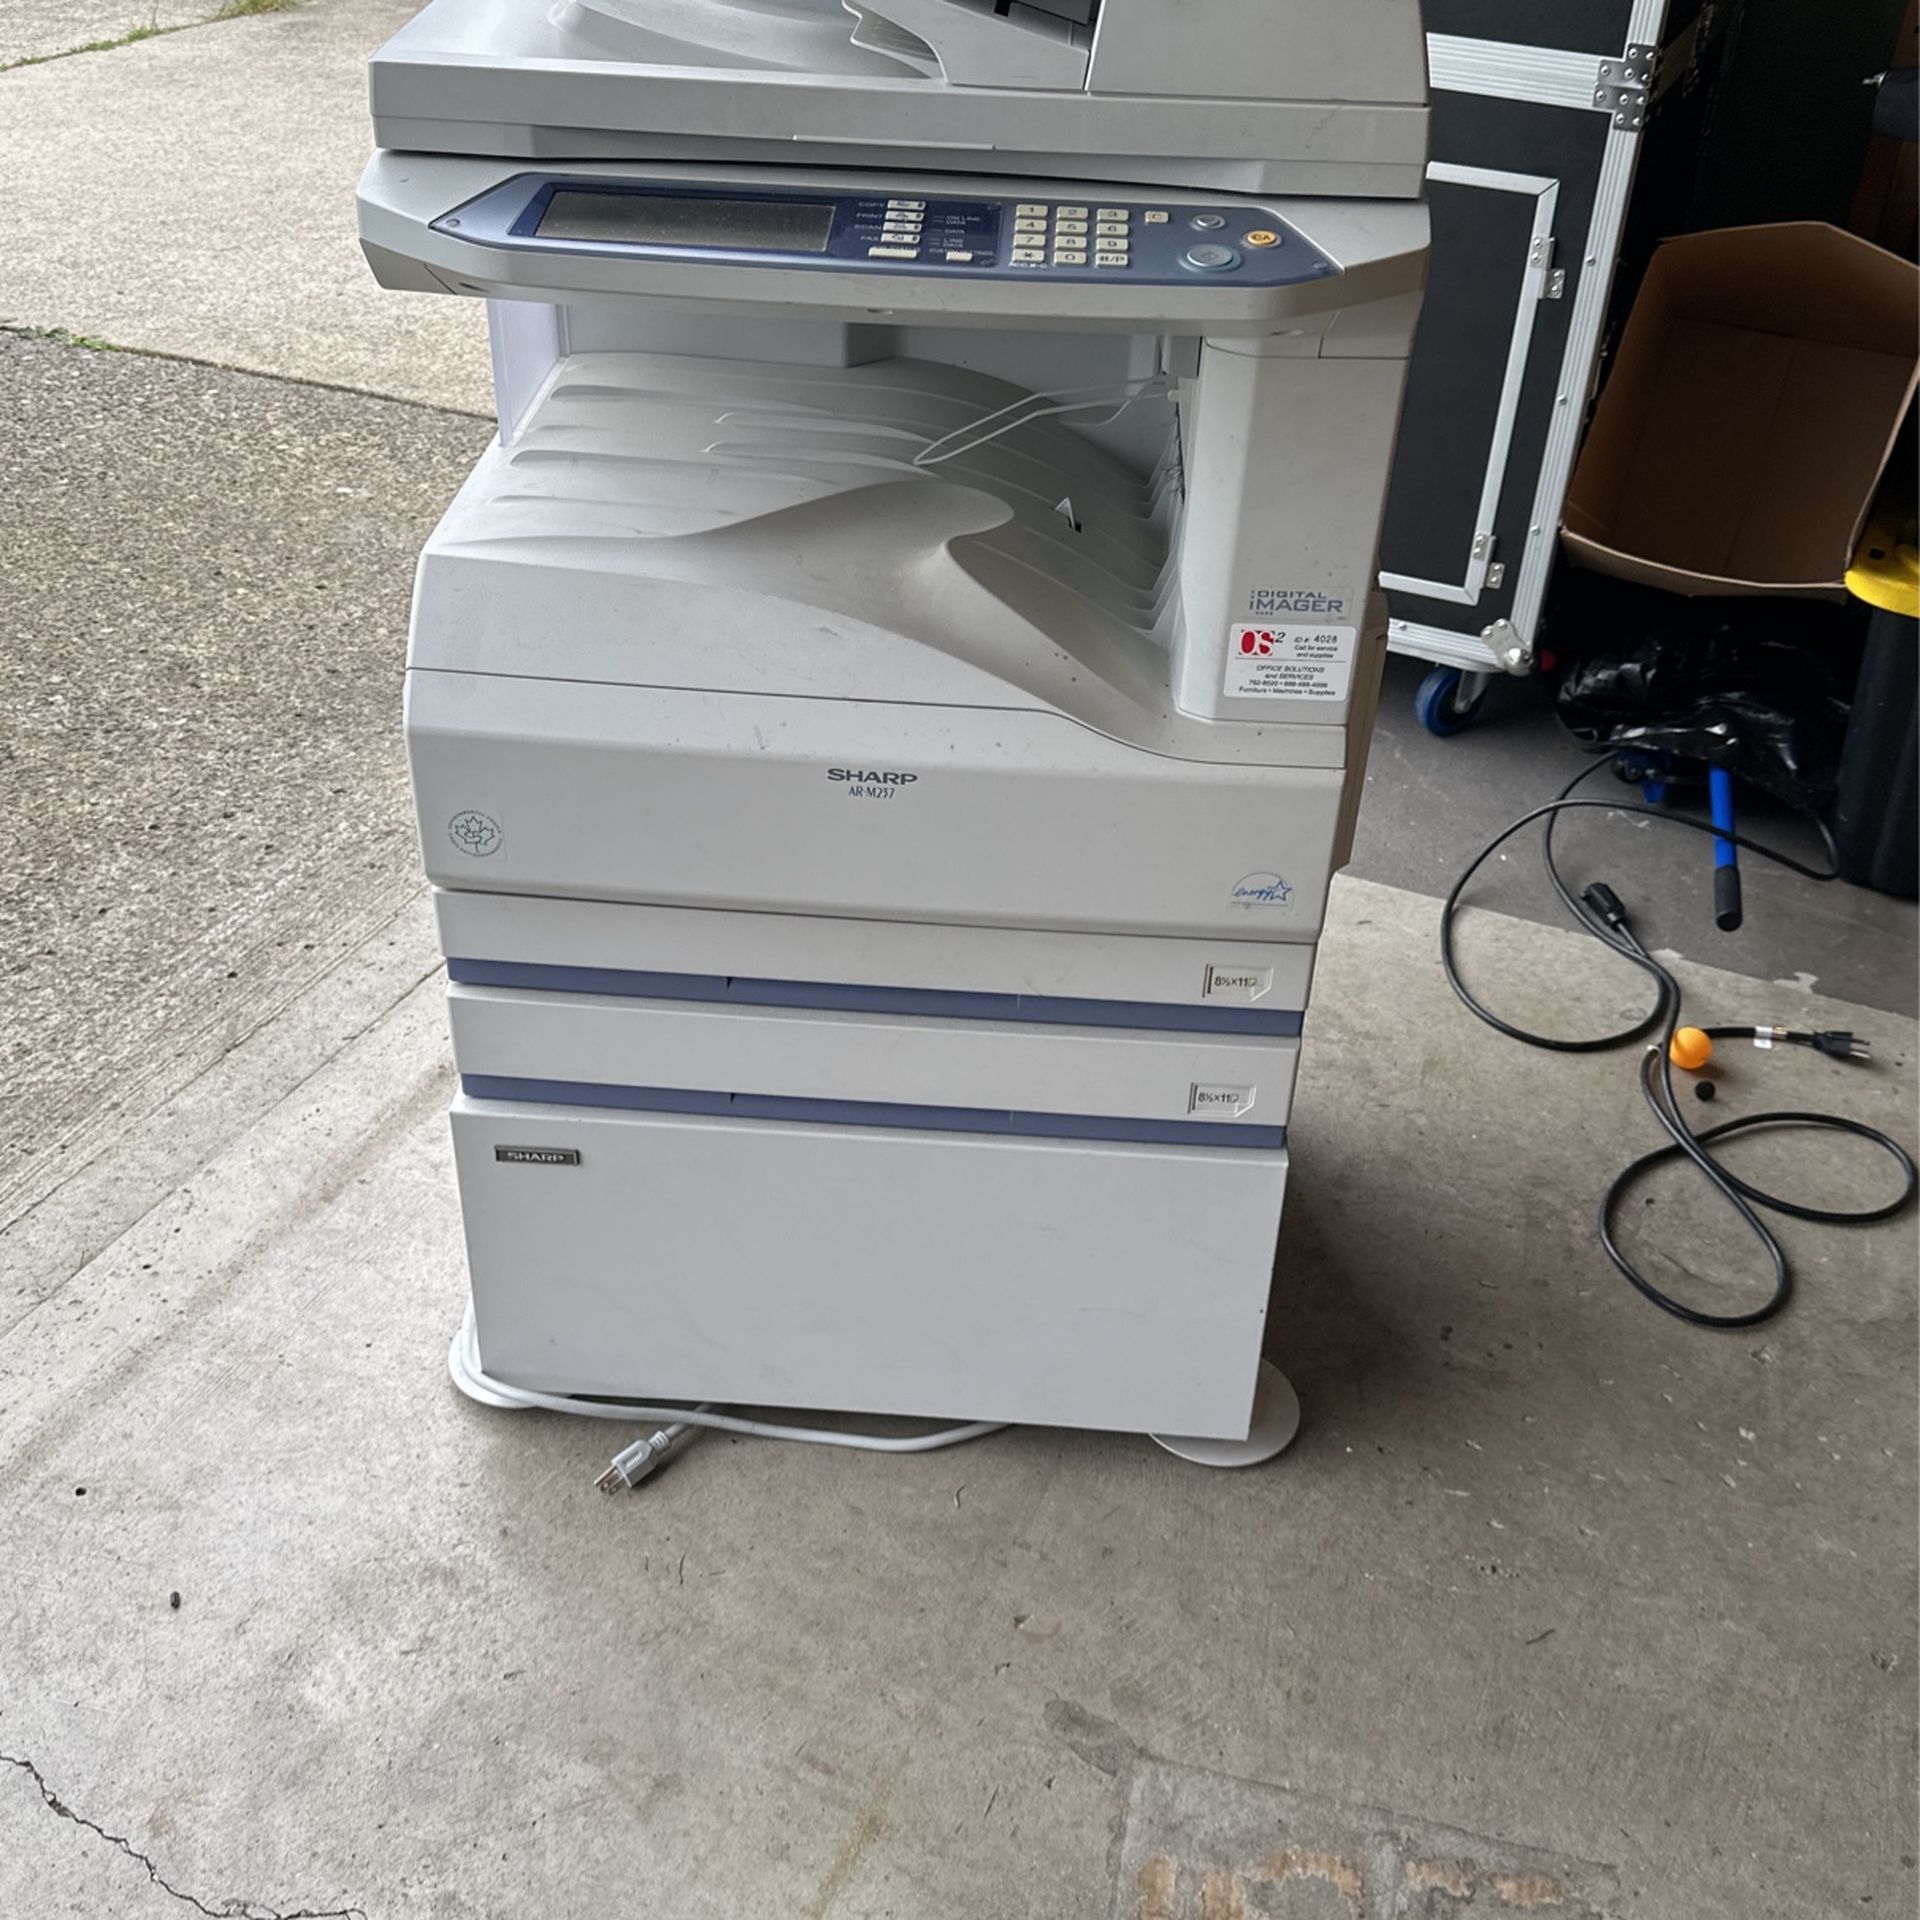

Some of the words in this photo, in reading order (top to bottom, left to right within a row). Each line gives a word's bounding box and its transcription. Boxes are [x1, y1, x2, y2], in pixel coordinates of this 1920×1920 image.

[1257, 590, 1327, 600] DIGITAL
[1313, 634, 1338, 645] 4028
[1272, 687, 1303, 695] Machines
[1308, 688, 1336, 697] Supplies
[827, 768, 918, 785] SHARP
[848, 785, 895, 800] AR-M237
[507, 1151, 565, 1162] SHARP
